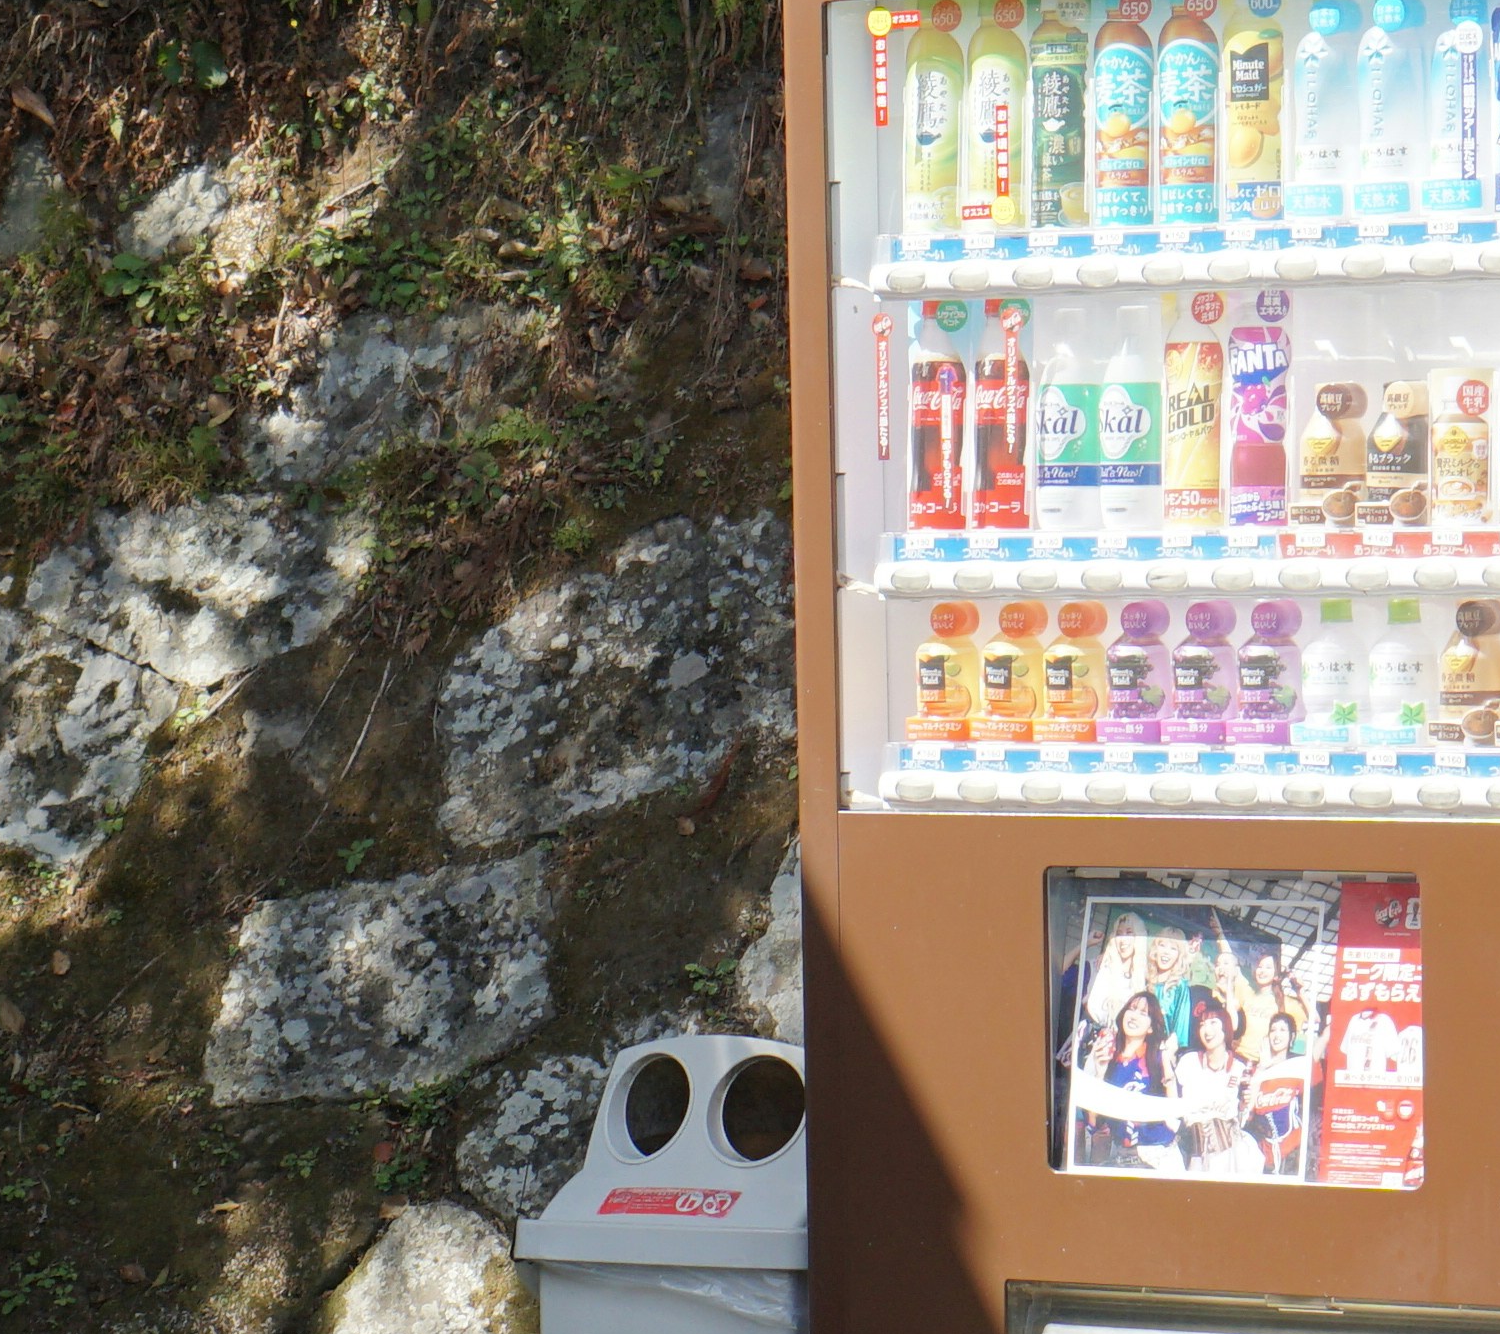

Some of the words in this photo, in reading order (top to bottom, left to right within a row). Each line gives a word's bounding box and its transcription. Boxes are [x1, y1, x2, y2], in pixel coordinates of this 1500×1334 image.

[1121, 2, 1149, 16] 650
[891, 13, 919, 24] オススメ
[1232, 59, 1265, 70] Minute
[1235, 70, 1260, 81] Maid
[1095, 70, 1150, 106] 麦茶
[1160, 67, 1214, 104] 麦茶
[915, 72, 938, 129] 綾鷹
[1042, 72, 1062, 118] 綾鷹
[1293, 195, 1332, 209] 天然水
[1361, 192, 1399, 206] 天然水
[1428, 188, 1470, 203] 天然水
[963, 208, 990, 218] オススメ
[1433, 223, 1454, 231] ¥130
[1229, 342, 1288, 376] FANTA
[1168, 381, 1215, 408] REAL
[1462, 385, 1486, 396] 国産
[1319, 393, 1343, 404] 高級豆
[1462, 396, 1486, 408] 牛乳
[1320, 404, 1341, 413] ブレンド
[1167, 407, 1215, 434] GOLD
[973, 501, 1021, 513] コカ・コーラ
